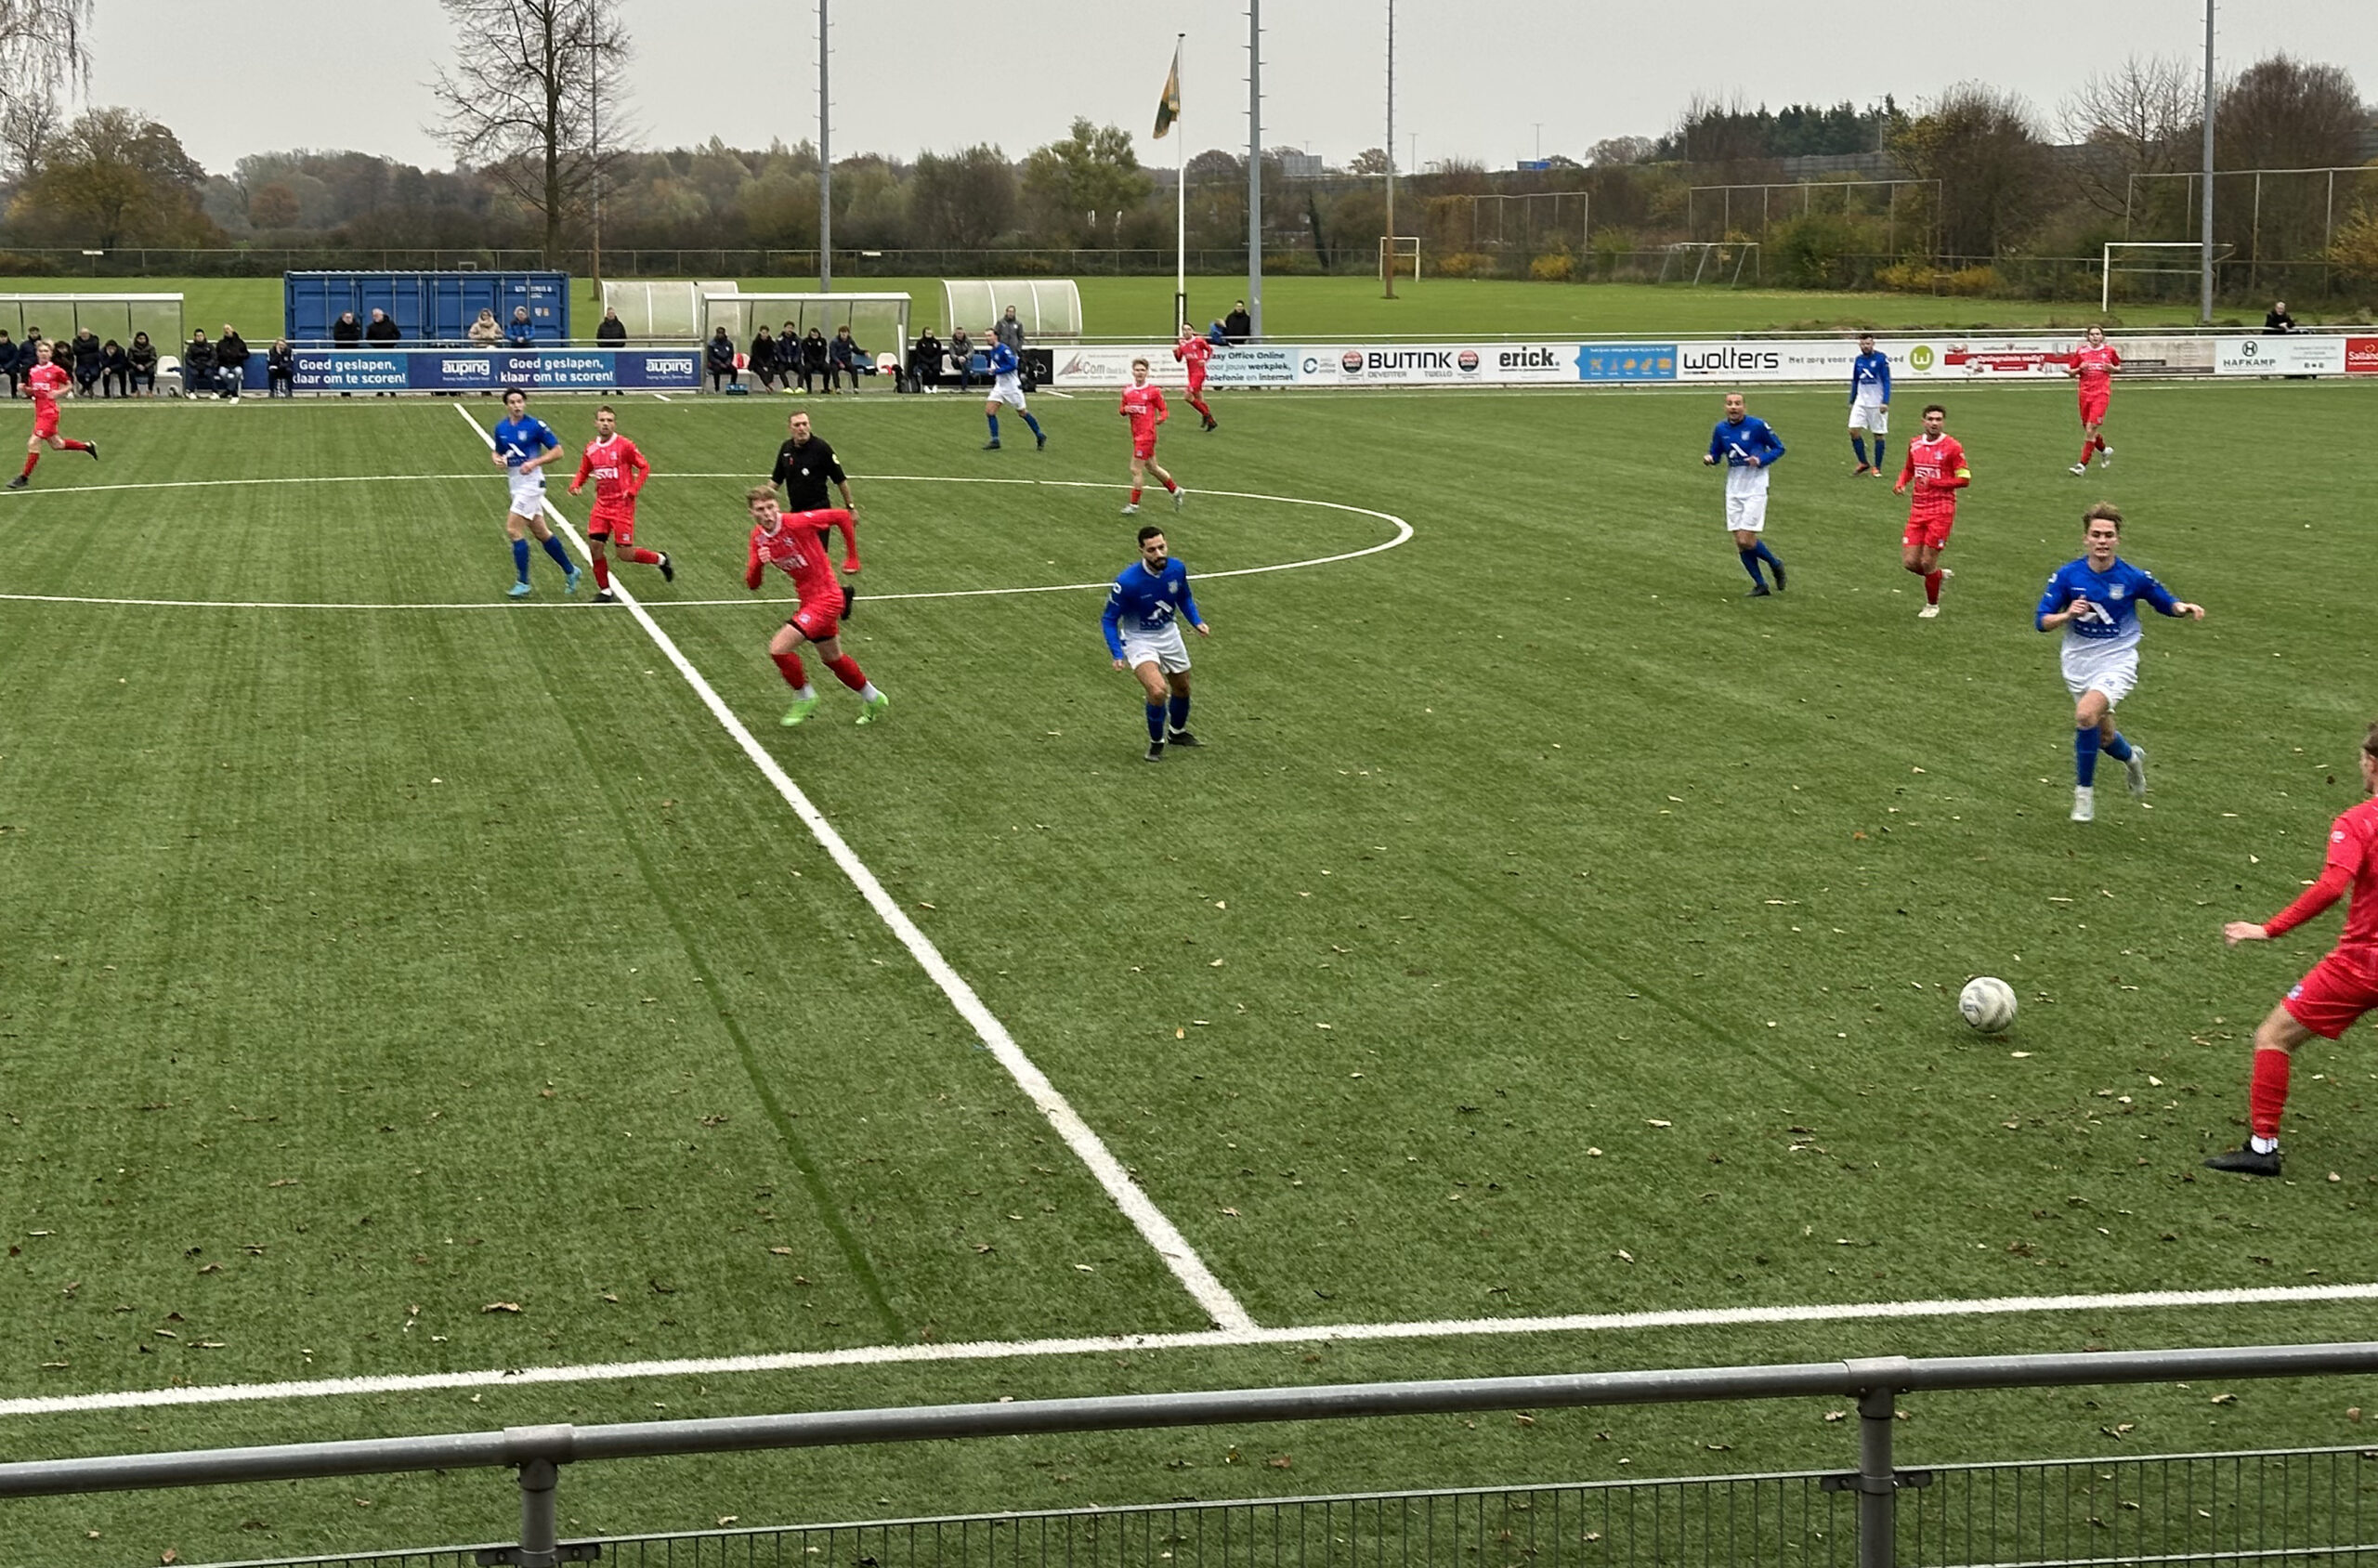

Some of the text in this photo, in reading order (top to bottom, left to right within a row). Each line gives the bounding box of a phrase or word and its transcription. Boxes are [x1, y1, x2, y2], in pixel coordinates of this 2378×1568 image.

[509, 358, 604, 371] Goed geslapen,
[1368, 352, 1452, 369] BUITINK
[1684, 347, 1779, 369] wolters
[2223, 359, 2276, 367] HAFKAMP
[299, 358, 396, 372] Goed geslapen,
[442, 360, 490, 376] auping
[646, 359, 693, 374] auping
[1248, 362, 1291, 372] werkplek,
[324, 374, 343, 384] om
[346, 373, 359, 384] te
[362, 372, 406, 383] scoren!
[500, 372, 531, 383] klaar
[533, 373, 552, 382] om
[555, 372, 568, 382] te
[569, 372, 614, 382] scoren!
